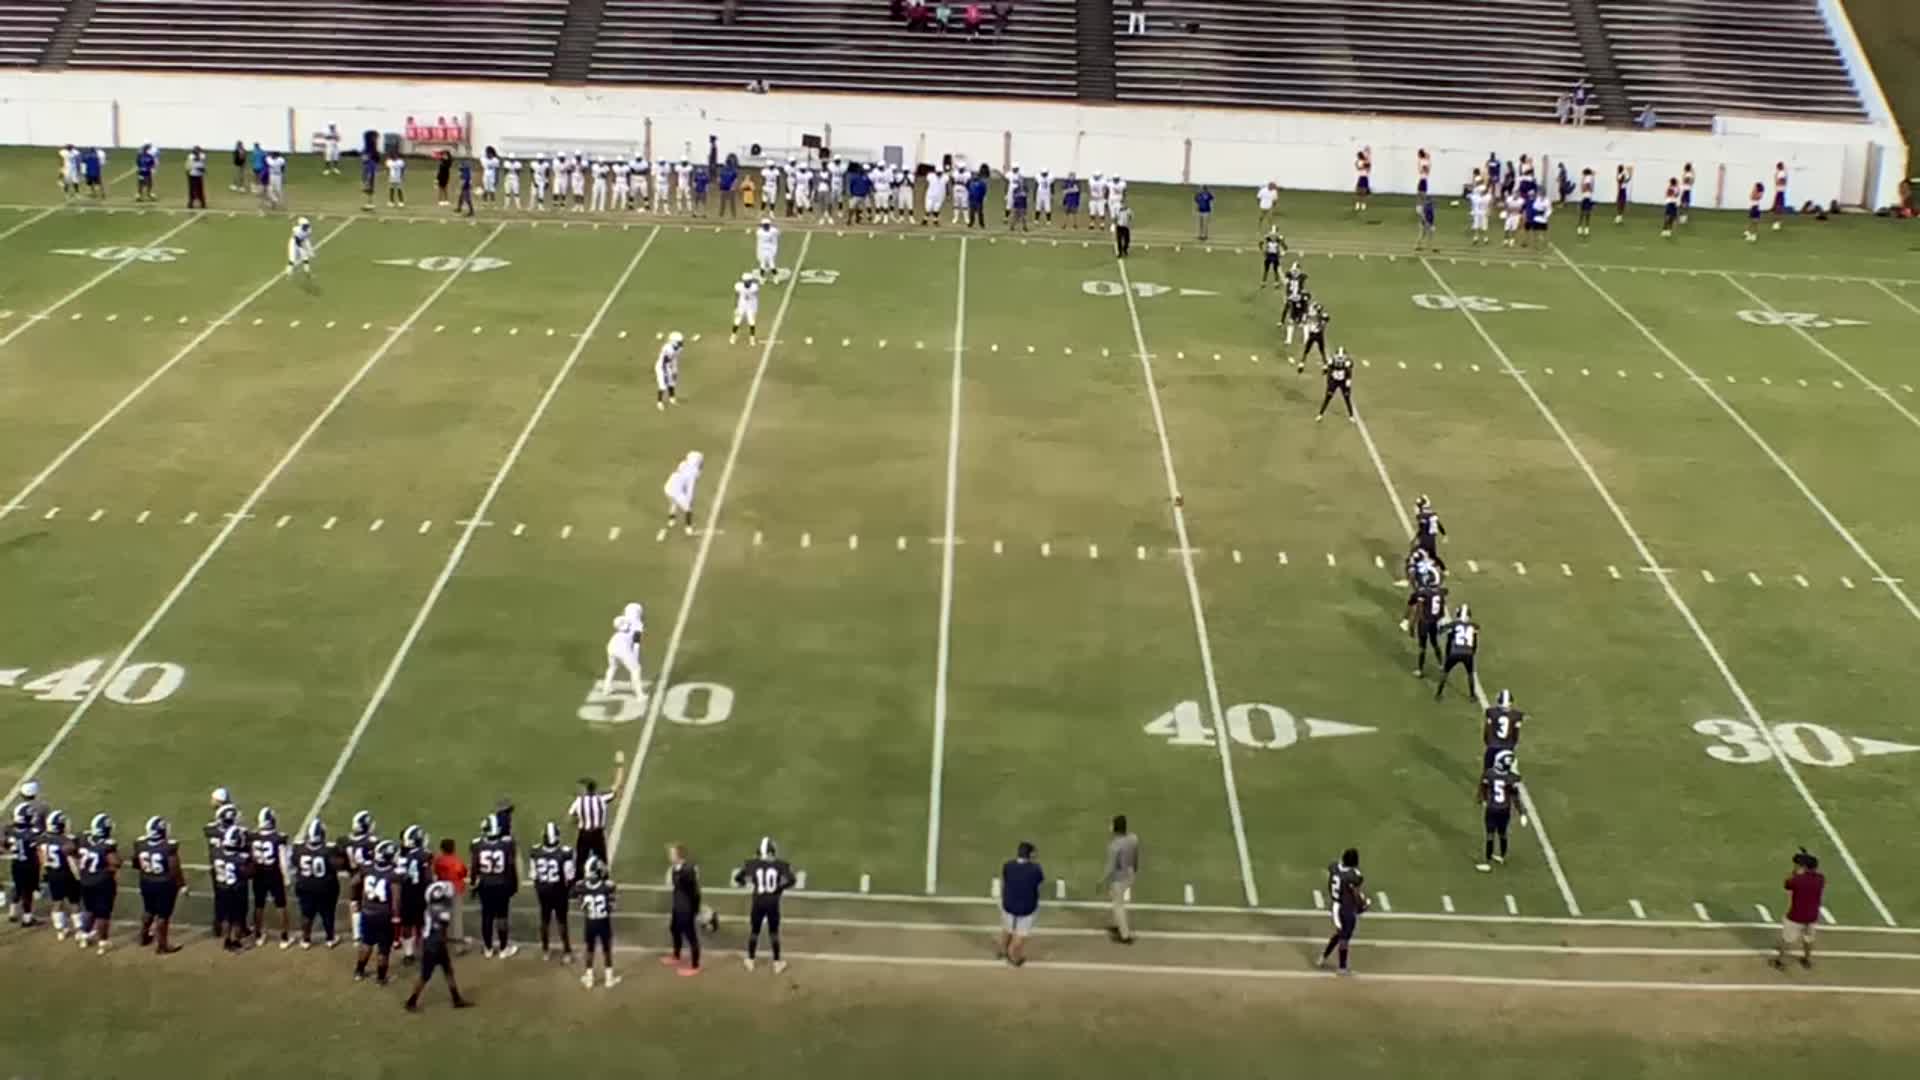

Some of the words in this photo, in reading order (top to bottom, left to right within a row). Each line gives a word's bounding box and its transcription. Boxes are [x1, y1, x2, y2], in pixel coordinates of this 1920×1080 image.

[1455, 625, 1475, 647] 24
[22, 658, 186, 704] 40
[577, 679, 735, 725] 50
[1144, 700, 1298, 749] 40
[1496, 715, 1509, 739] 3
[1692, 718, 1856, 767] 30
[1493, 779, 1506, 804] 5
[480, 850, 505, 873] 53
[536, 858, 561, 883] 22
[756, 867, 778, 893] 10
